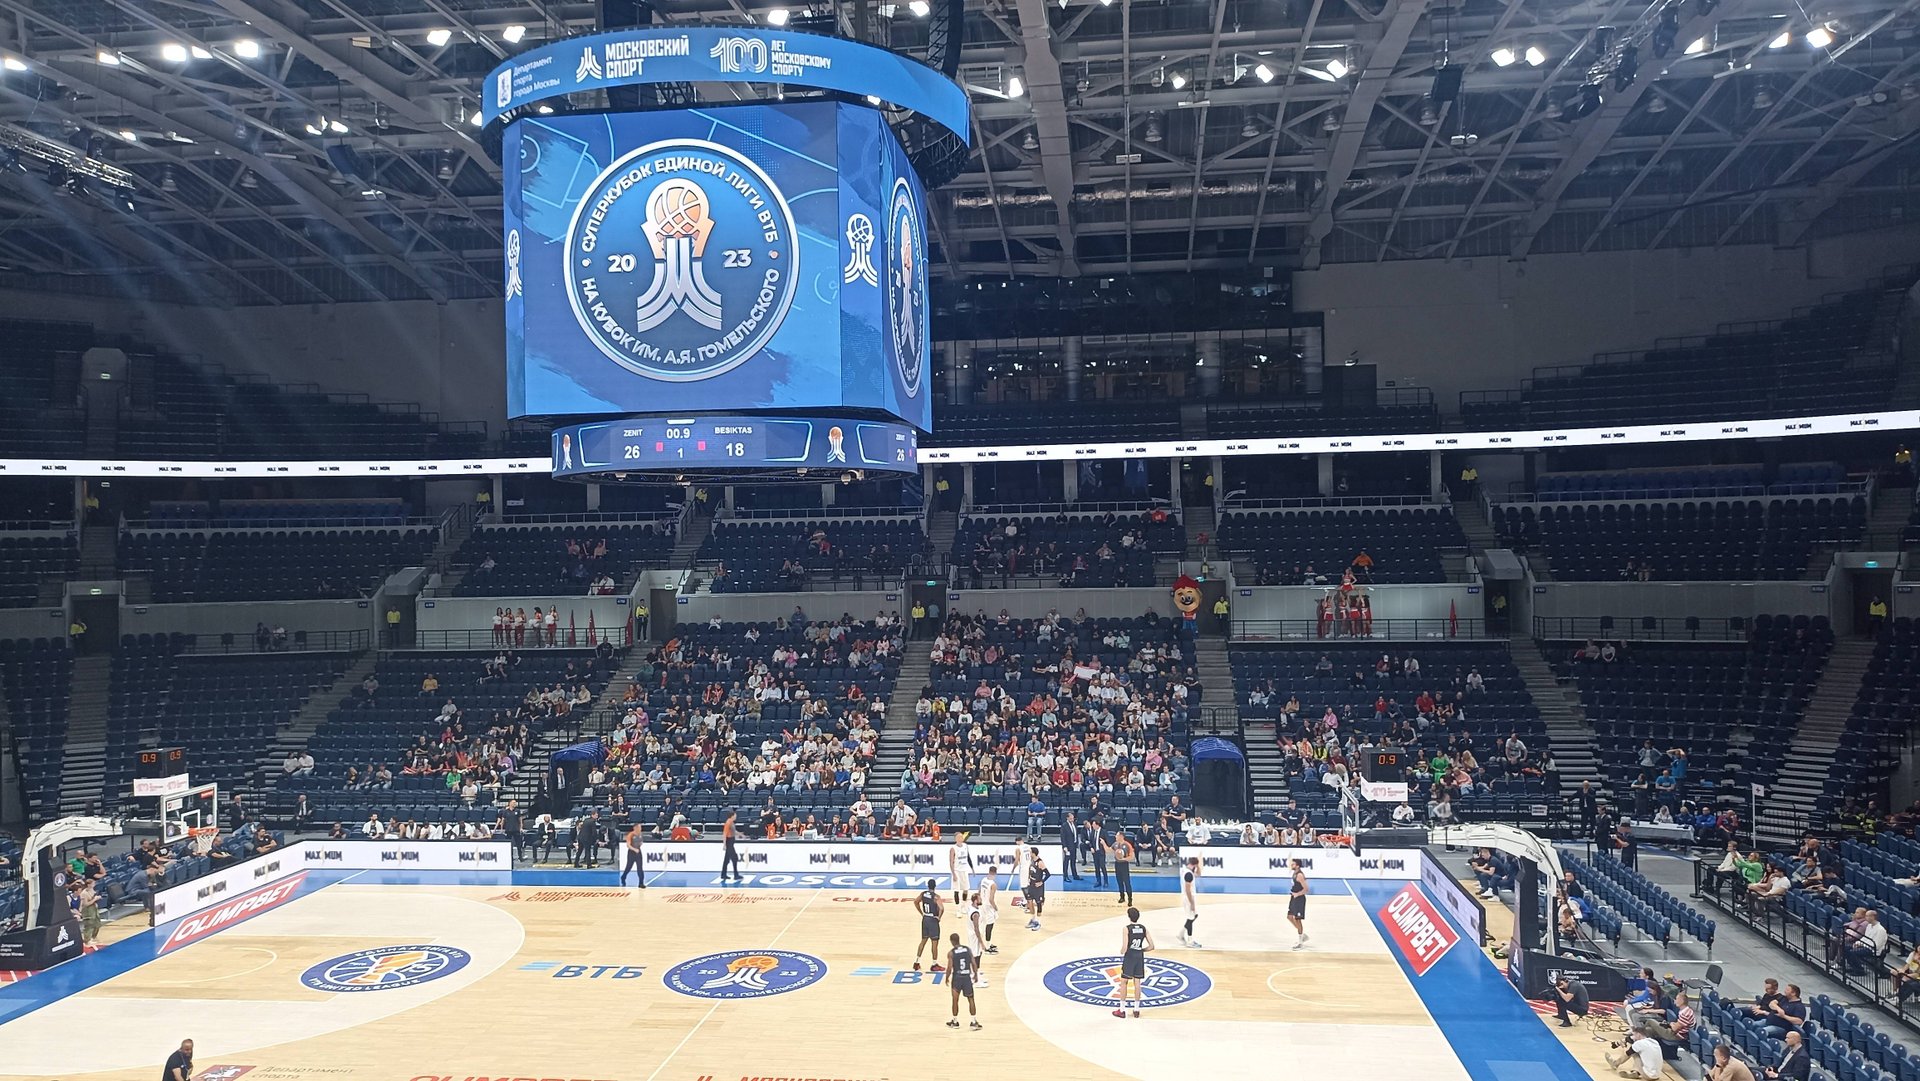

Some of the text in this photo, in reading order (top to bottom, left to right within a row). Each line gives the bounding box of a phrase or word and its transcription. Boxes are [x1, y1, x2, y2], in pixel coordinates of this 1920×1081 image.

[605, 34, 690, 60] МОСКОВСКИЙ
[771, 40, 786, 52] ЛЕТ
[710, 37, 767, 74] 100
[771, 52, 832, 70] МОСКОВСКОМУ
[513, 57, 553, 77] Департамент
[605, 58, 644, 79] СПОРТ
[771, 63, 803, 77] СПОРТУ
[533, 78, 560, 92] Москвы
[582, 156, 779, 254] СУПЕРКУБОК ЕДИНОЙ ЛИГИ ВТБ
[607, 253, 637, 273] 20
[722, 249, 753, 268] 23
[581, 267, 780, 365] НА КУБОК ИМ. А.Я. ГОМЕЛЬСКОГО
[623, 428, 643, 438] ZENIT
[666, 427, 691, 439] 00.9
[714, 426, 753, 436] BESIKTAS
[624, 445, 641, 459] 26
[677, 448, 684, 458] 1
[725, 442, 745, 457] 18
[142, 754, 156, 763] 0.9
[1379, 755, 1396, 765] 0.9
[710, 874, 950, 886] MOSCOW
[174, 878, 302, 942] OLIMPBET
[1387, 891, 1449, 963] OLIMPBET
[1130, 938, 1142, 949] 20
[960, 958, 966, 970] 5
[552, 965, 648, 979] ВТБ
[892, 971, 947, 985] ВТ
[366, 978, 421, 991] LEAGUE
[1144, 976, 1180, 988] 15
[1065, 991, 1088, 1001] VTB
[1141, 993, 1191, 1007] LEAGUE
